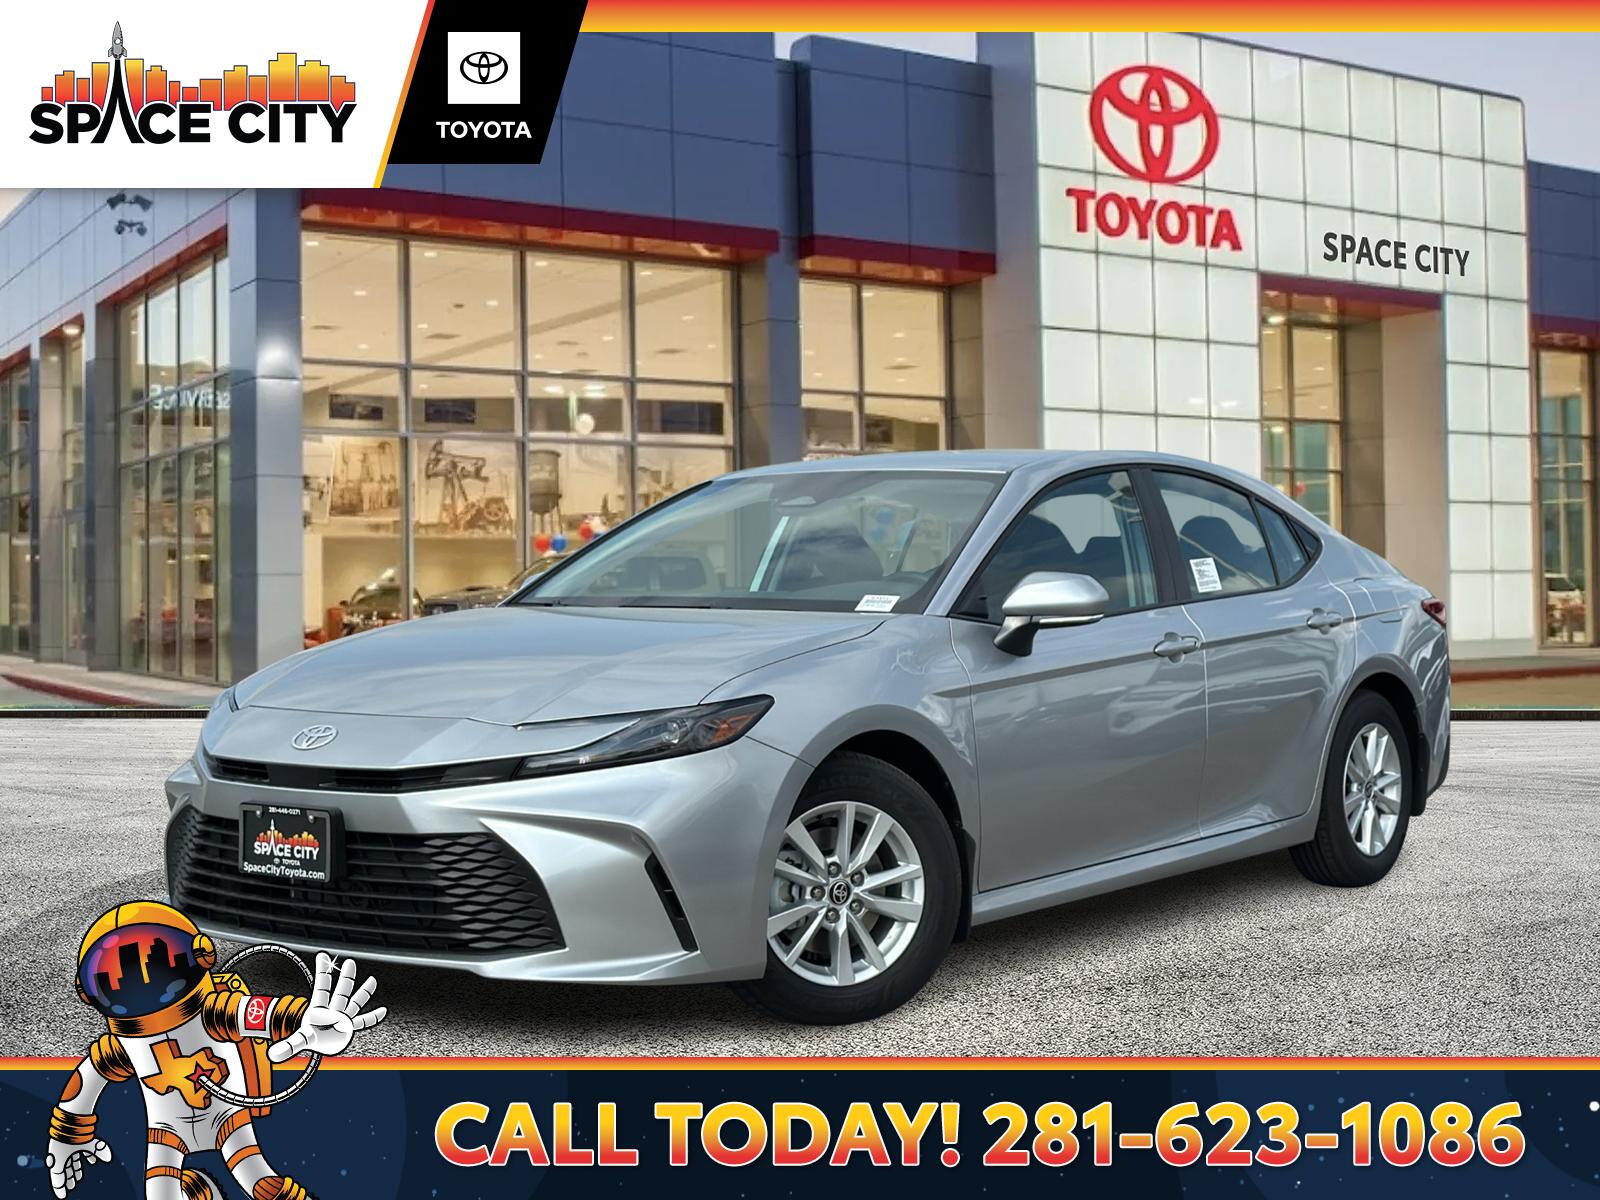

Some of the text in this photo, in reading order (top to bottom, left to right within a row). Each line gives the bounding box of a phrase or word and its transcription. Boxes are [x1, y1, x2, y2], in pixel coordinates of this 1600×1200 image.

[1066, 188, 1242, 251] TOYOTA
[1323, 231, 1470, 277] SPACE CITY
[253, 830, 319, 860] SPACE CITY
[243, 861, 325, 880] SpaceCityToyota.com
[282, 858, 301, 866] TOYOTA
